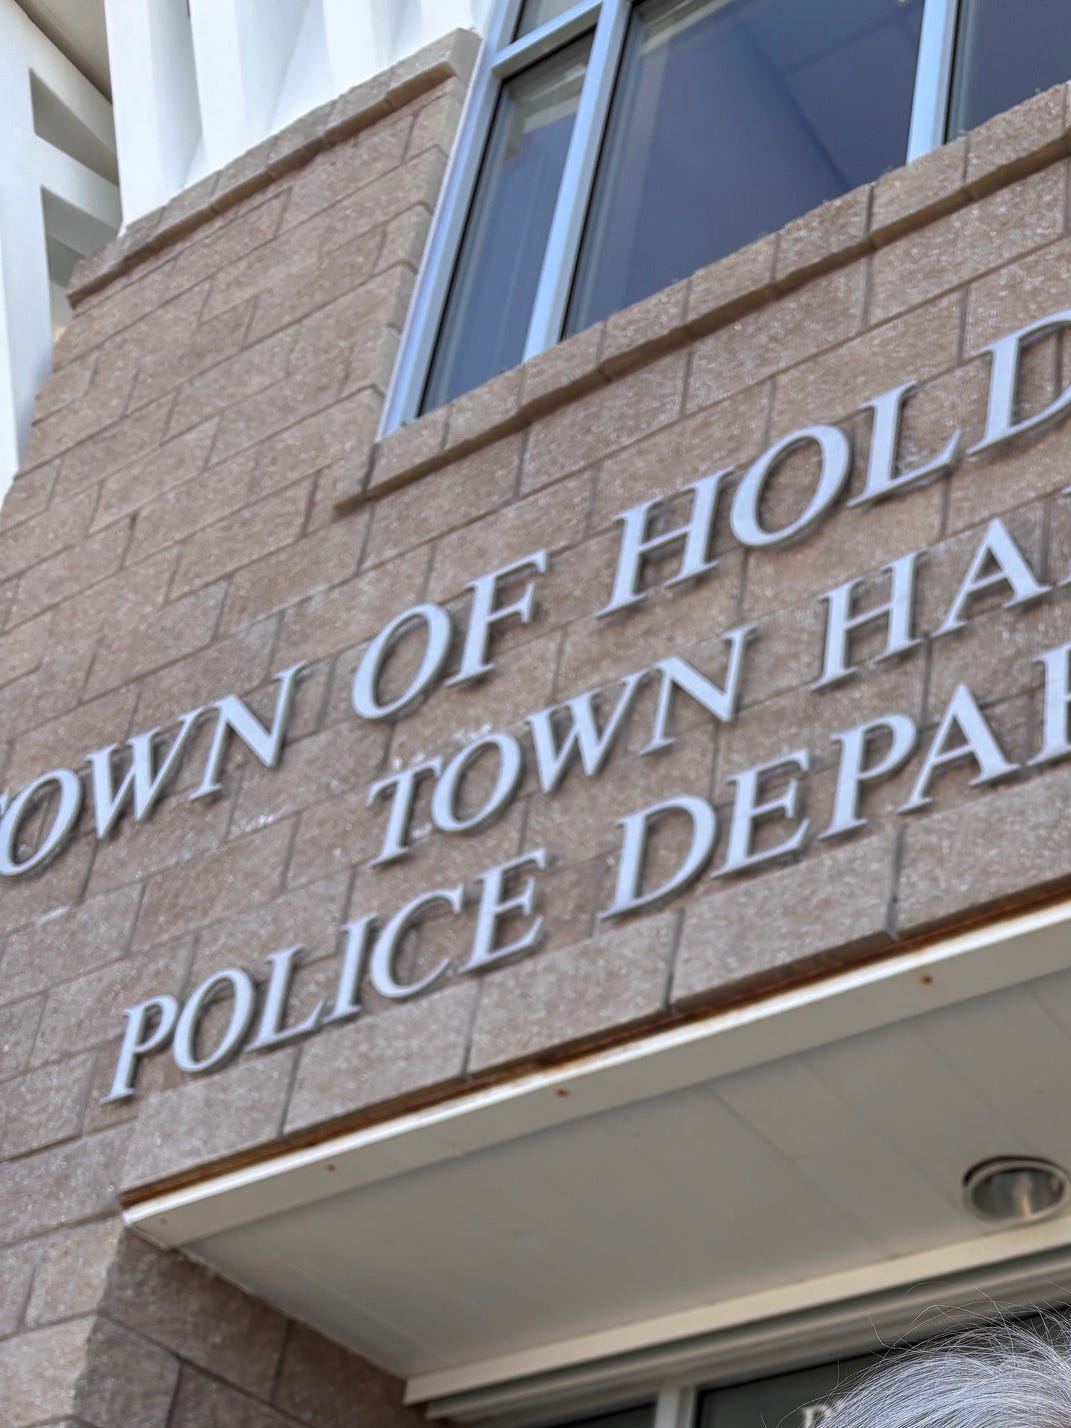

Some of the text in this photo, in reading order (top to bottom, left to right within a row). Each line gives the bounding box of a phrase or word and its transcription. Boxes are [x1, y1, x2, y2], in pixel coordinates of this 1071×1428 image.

[0, 660, 306, 876] OWN
[350, 548, 548, 719] OF
[365, 623, 758, 867] TOWN
[100, 847, 547, 1103] POLICE
